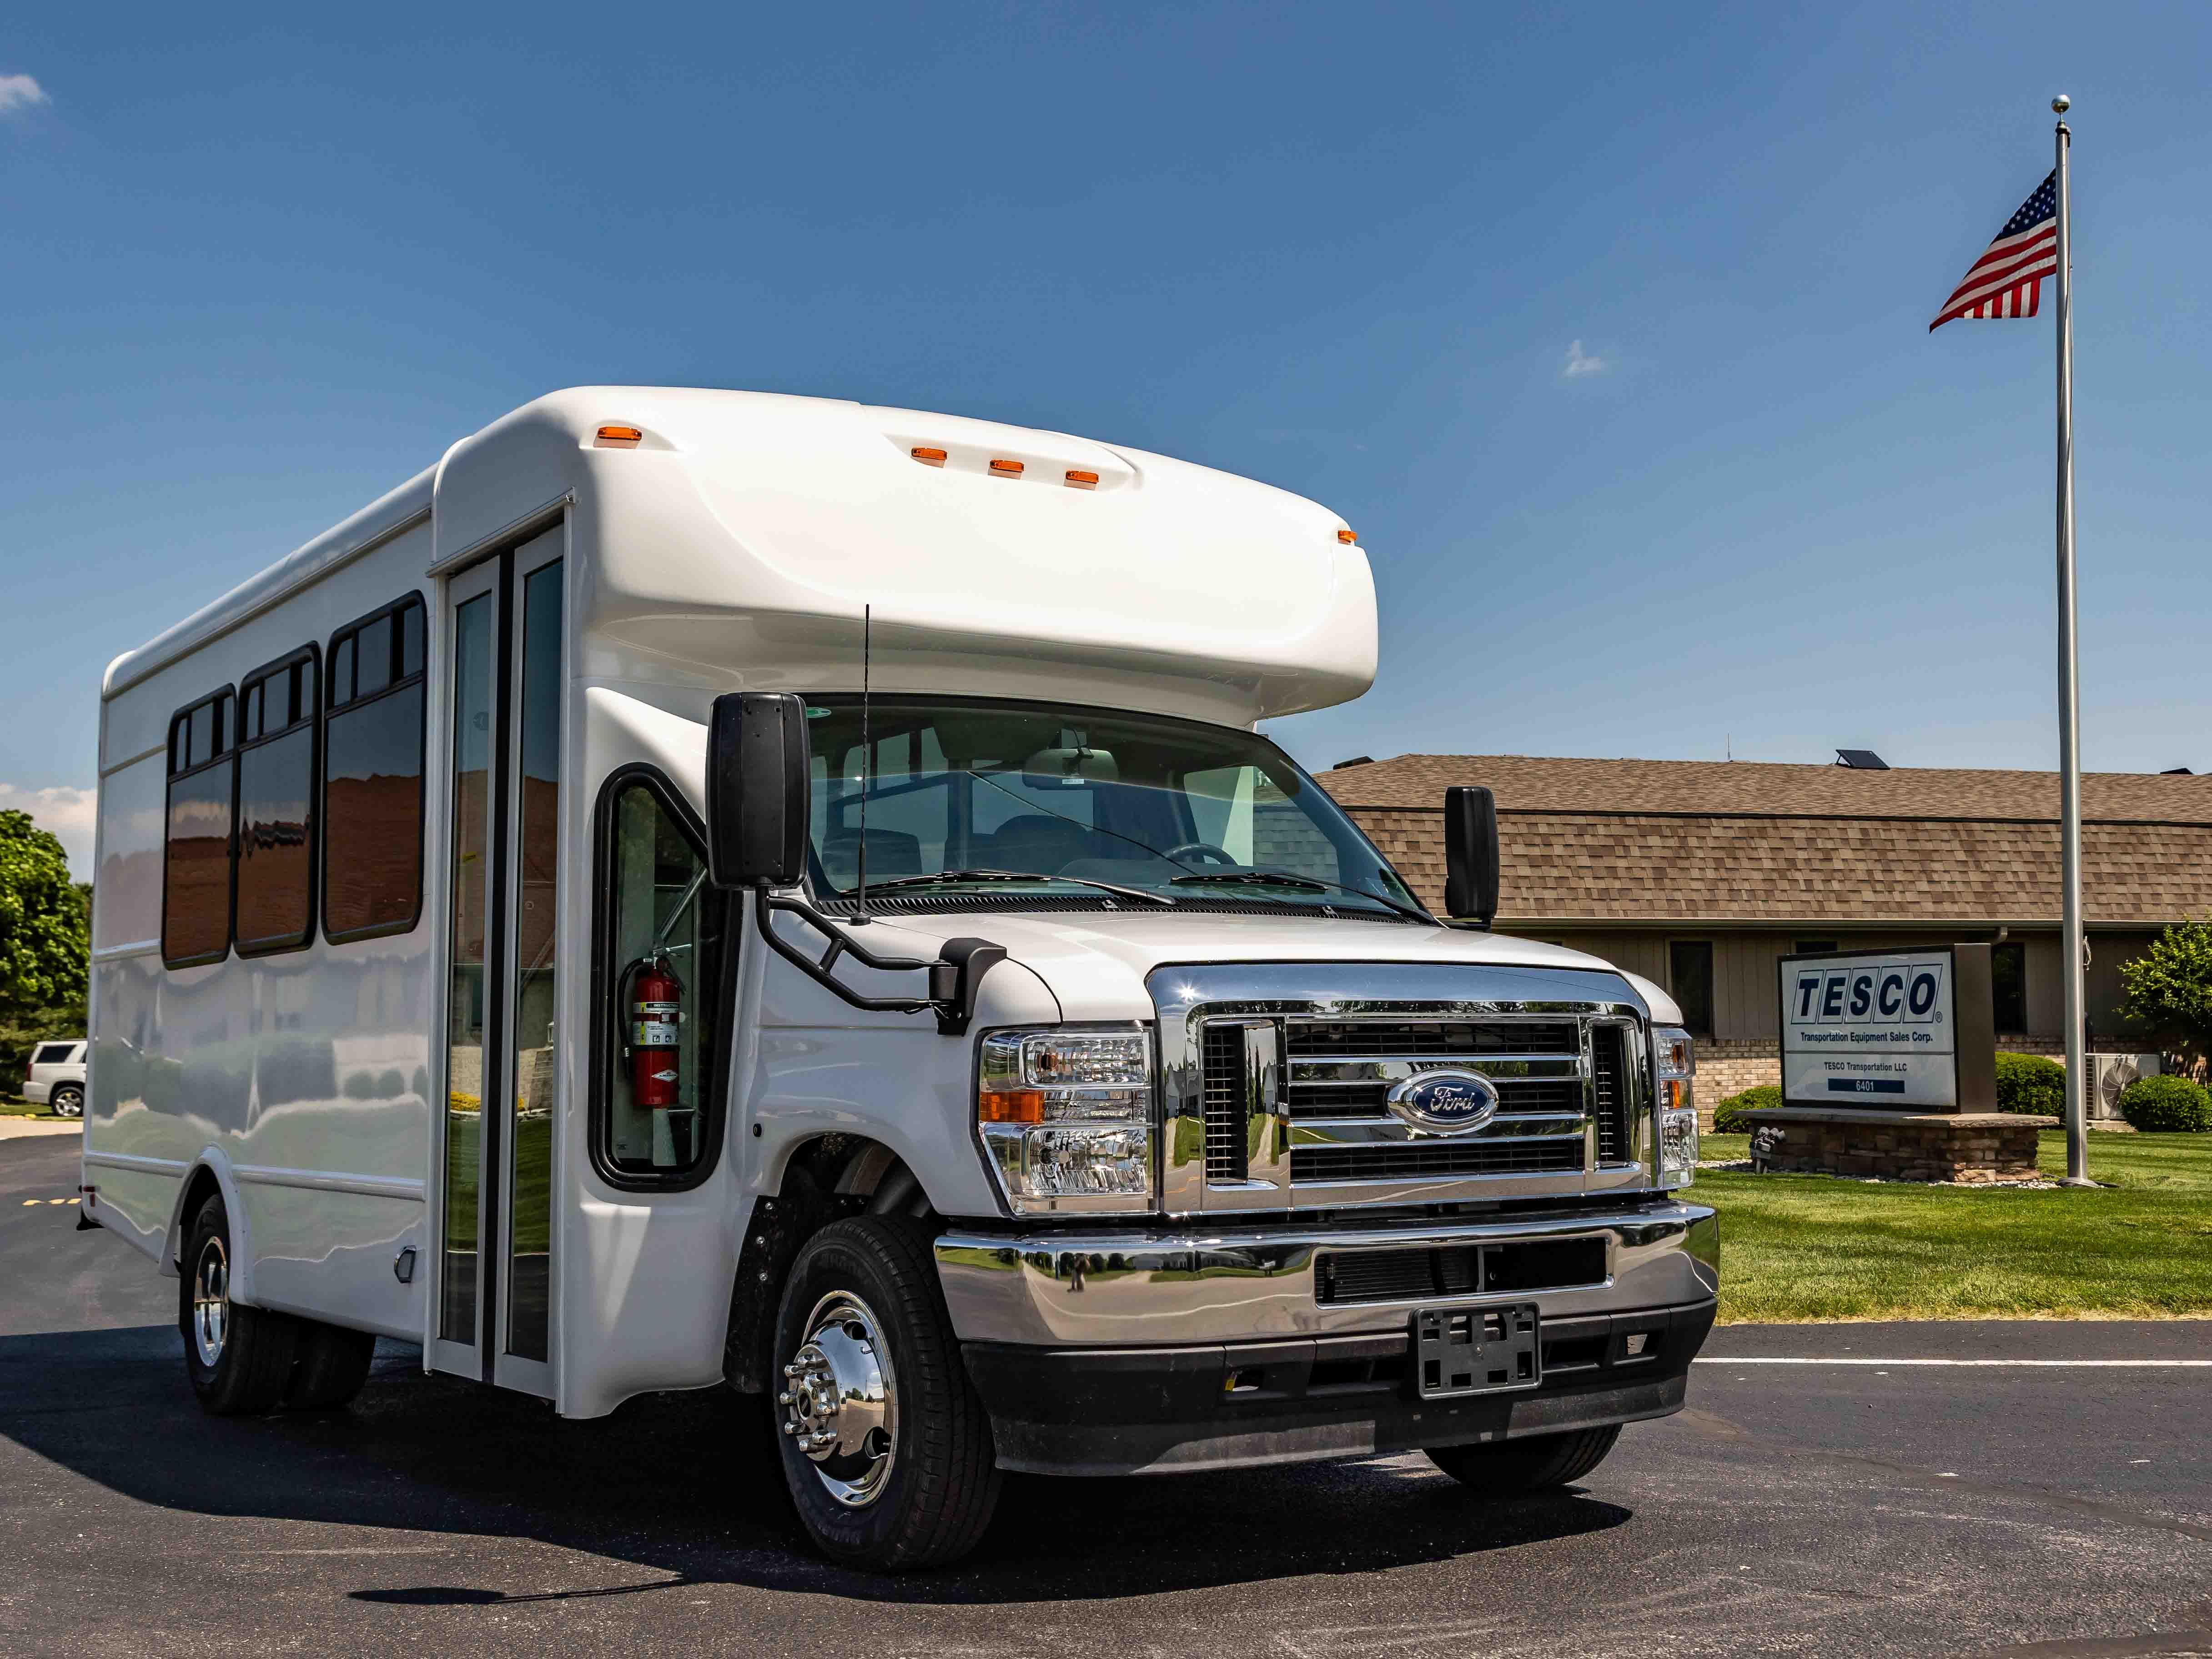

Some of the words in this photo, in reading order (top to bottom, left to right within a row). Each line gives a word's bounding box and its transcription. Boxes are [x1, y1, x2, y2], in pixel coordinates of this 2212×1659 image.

[1799, 973, 1936, 1016] TESCO
[1800, 1032, 1848, 1043] Transportation
[1850, 1032, 1887, 1044] Equipment
[1890, 1032, 1910, 1042] Sales
[1912, 1032, 1933, 1044] Corp.
[1824, 1062, 1845, 1070] TESCO
[1847, 1062, 1892, 1072] Transportation
[1894, 1063, 1907, 1071] LLC
[1856, 1080, 1874, 1091] 6401
[1430, 1086, 1475, 1112] Ford
